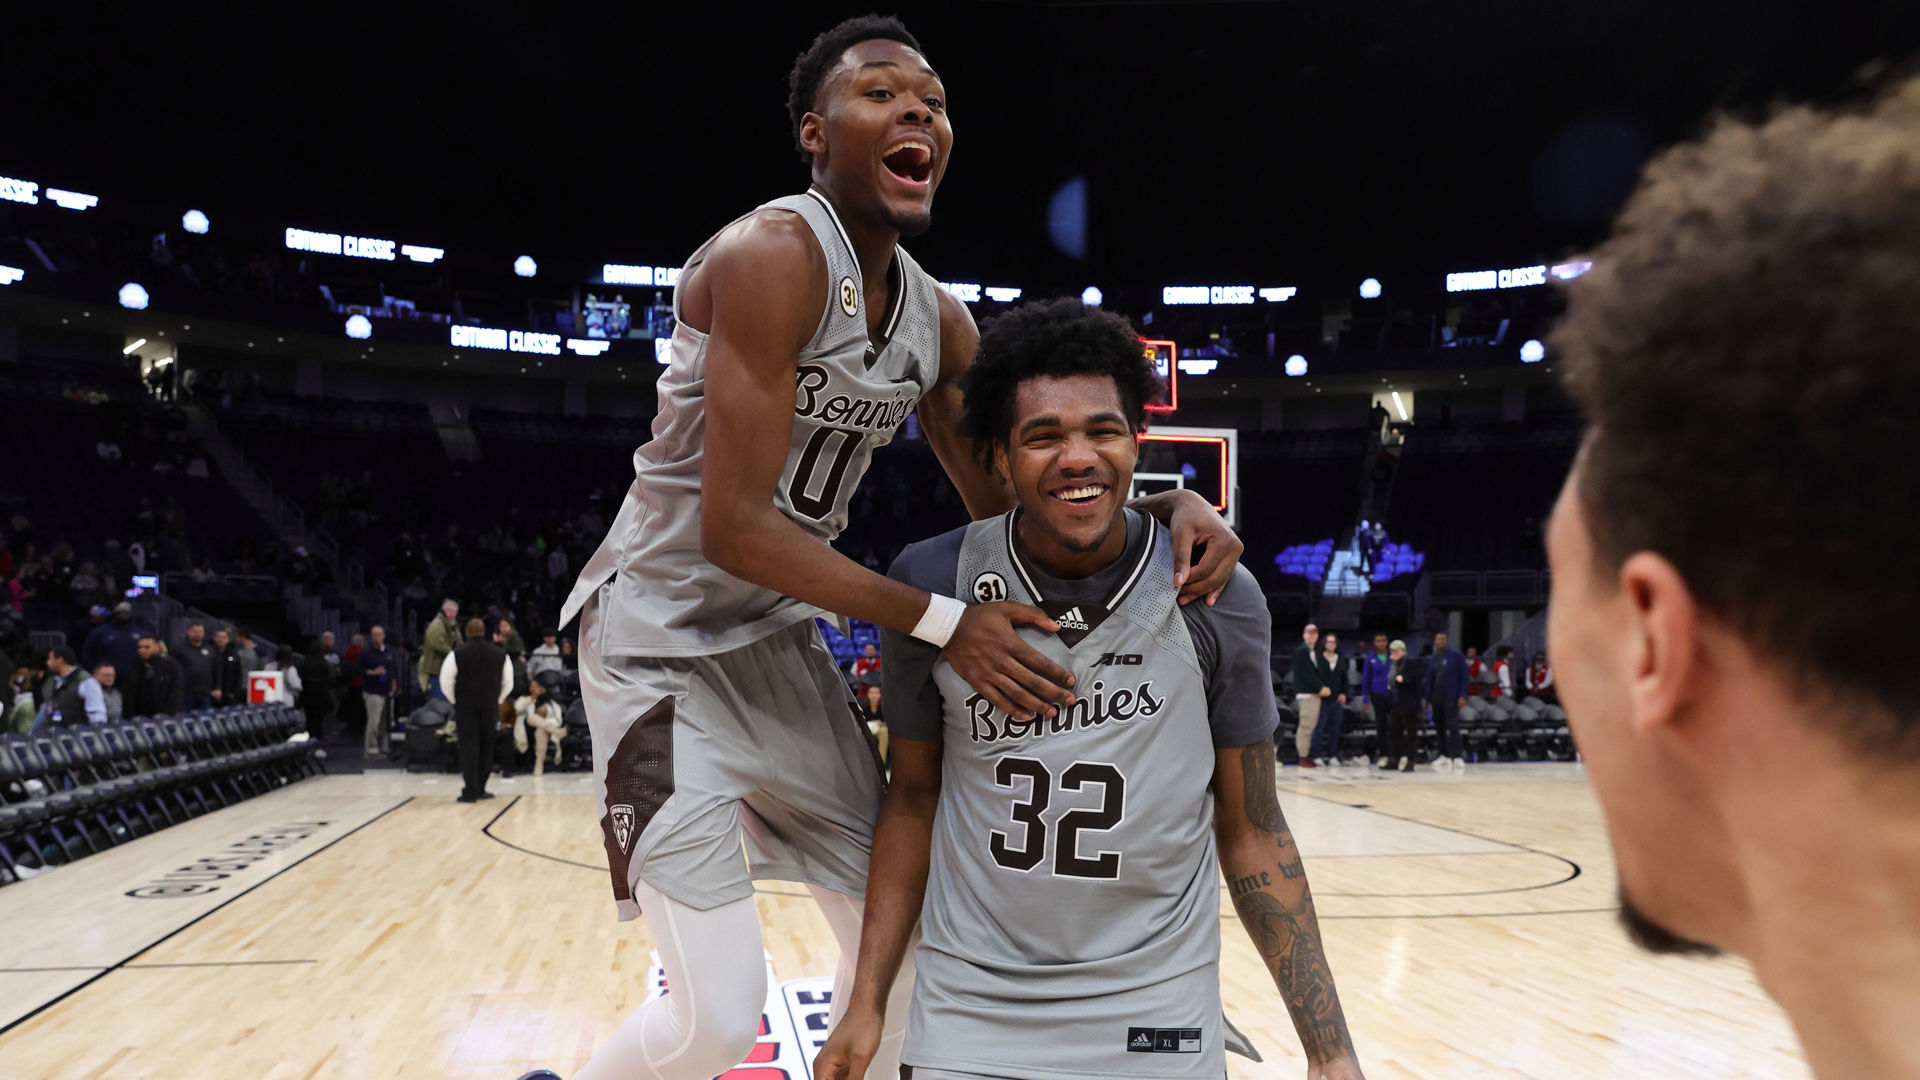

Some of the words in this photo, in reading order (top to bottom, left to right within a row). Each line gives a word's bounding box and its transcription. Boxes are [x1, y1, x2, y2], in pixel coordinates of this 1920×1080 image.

[286, 228, 342, 255] GOTHAM
[343, 236, 396, 261] CLASSIC
[603, 264, 653, 285] GOTHAM
[1446, 270, 1497, 292] GOTHAM
[1498, 265, 1546, 288] CLASSIC
[843, 285, 857, 309] 31
[1163, 286, 1210, 305] GOTHAM
[1210, 286, 1255, 304] CLASSIC
[450, 325, 508, 350] GOTHAM
[509, 330, 561, 356] CLASSIC
[795, 364, 916, 431] Bonnies
[787, 425, 866, 522] 0
[978, 579, 1003, 601] 31
[1055, 620, 1089, 631] adidas
[988, 754, 1127, 881] 32
[1162, 1038, 1172, 1048] XL
